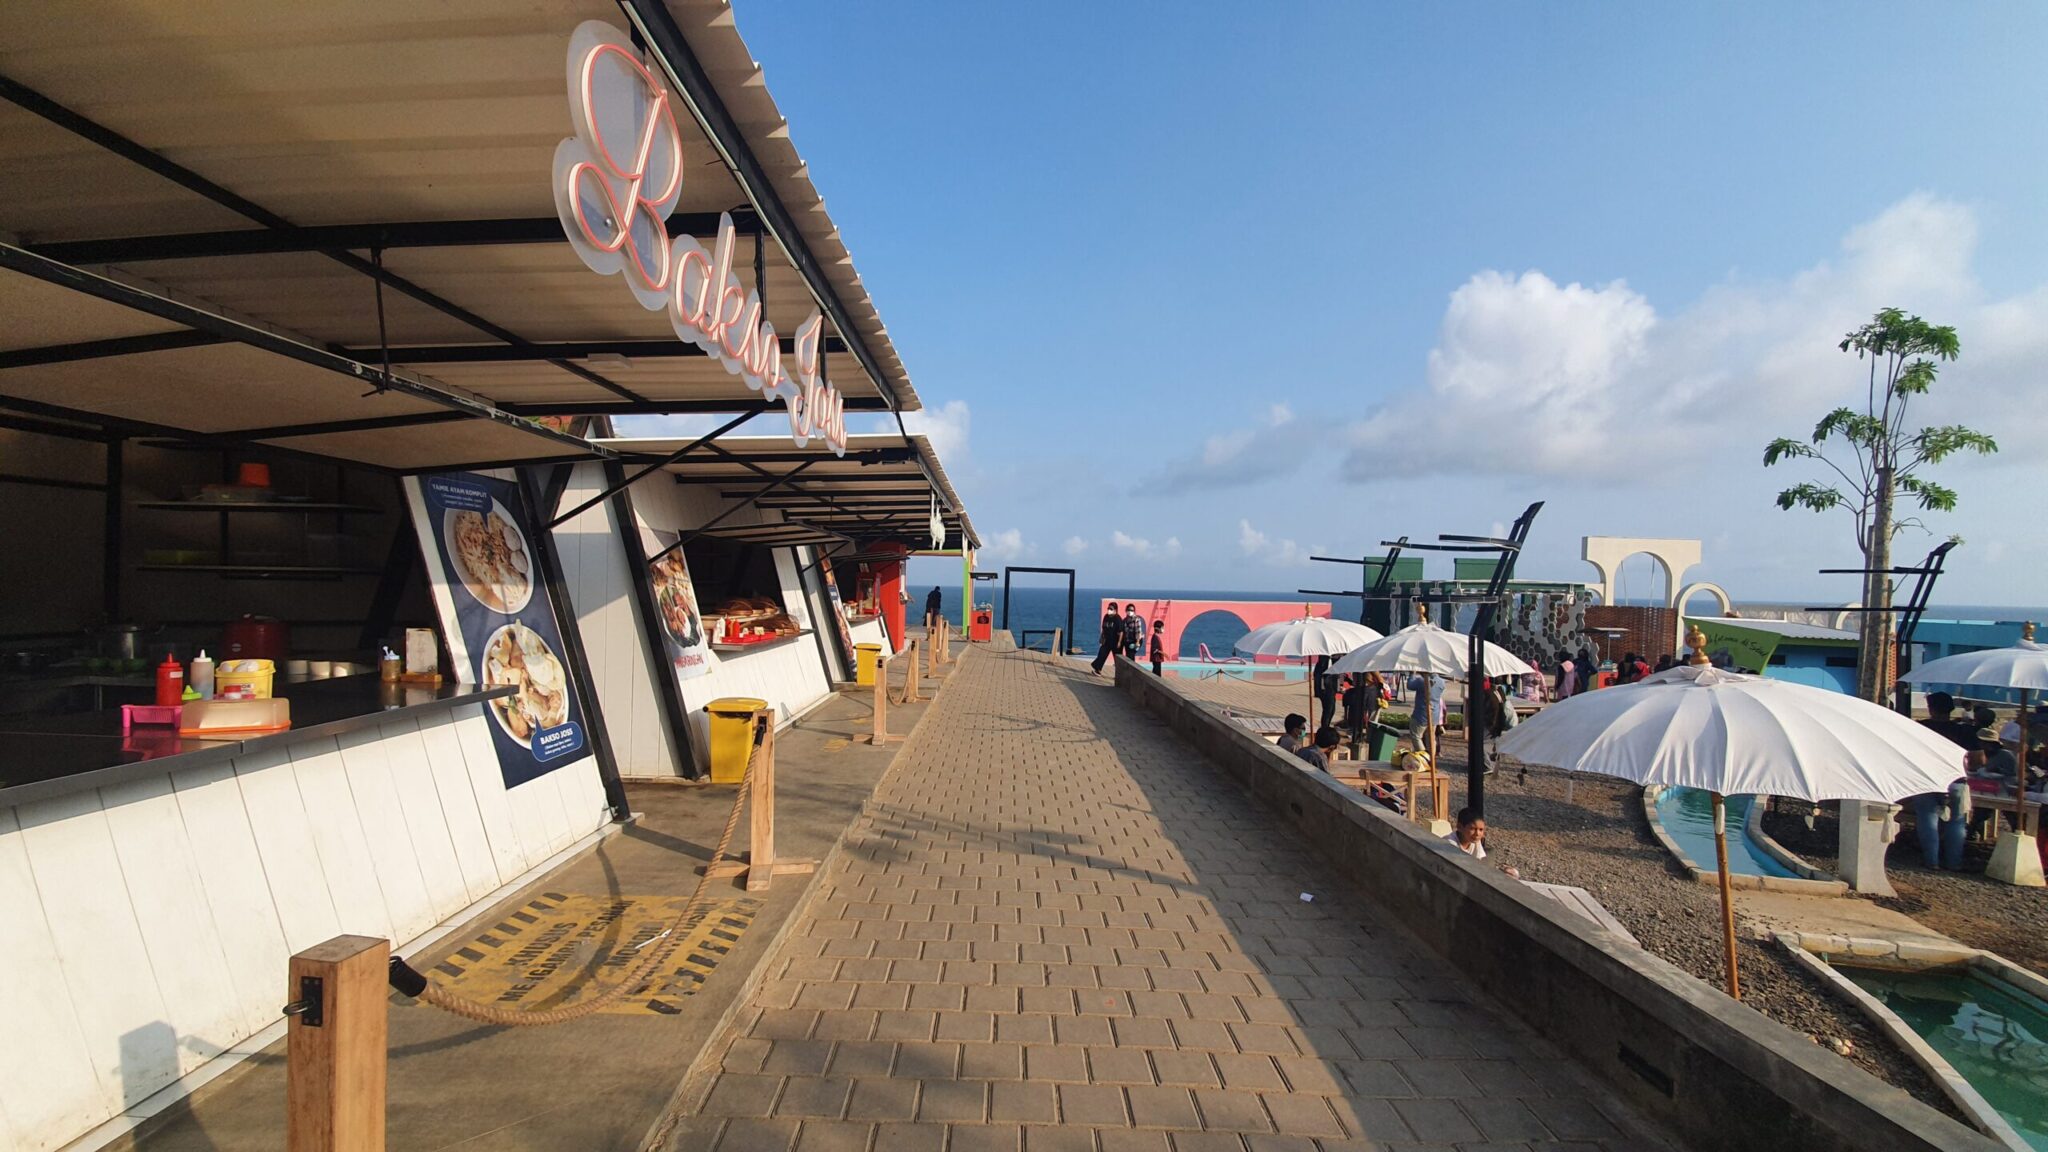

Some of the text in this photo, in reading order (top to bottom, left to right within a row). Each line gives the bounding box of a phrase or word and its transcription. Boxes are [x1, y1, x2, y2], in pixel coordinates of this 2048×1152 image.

[465, 489, 487, 498] KOMPLIT
[540, 732, 560, 745] BAKSO
[560, 728, 573, 738] JOSS
[503, 921, 579, 967] KHUSUS
